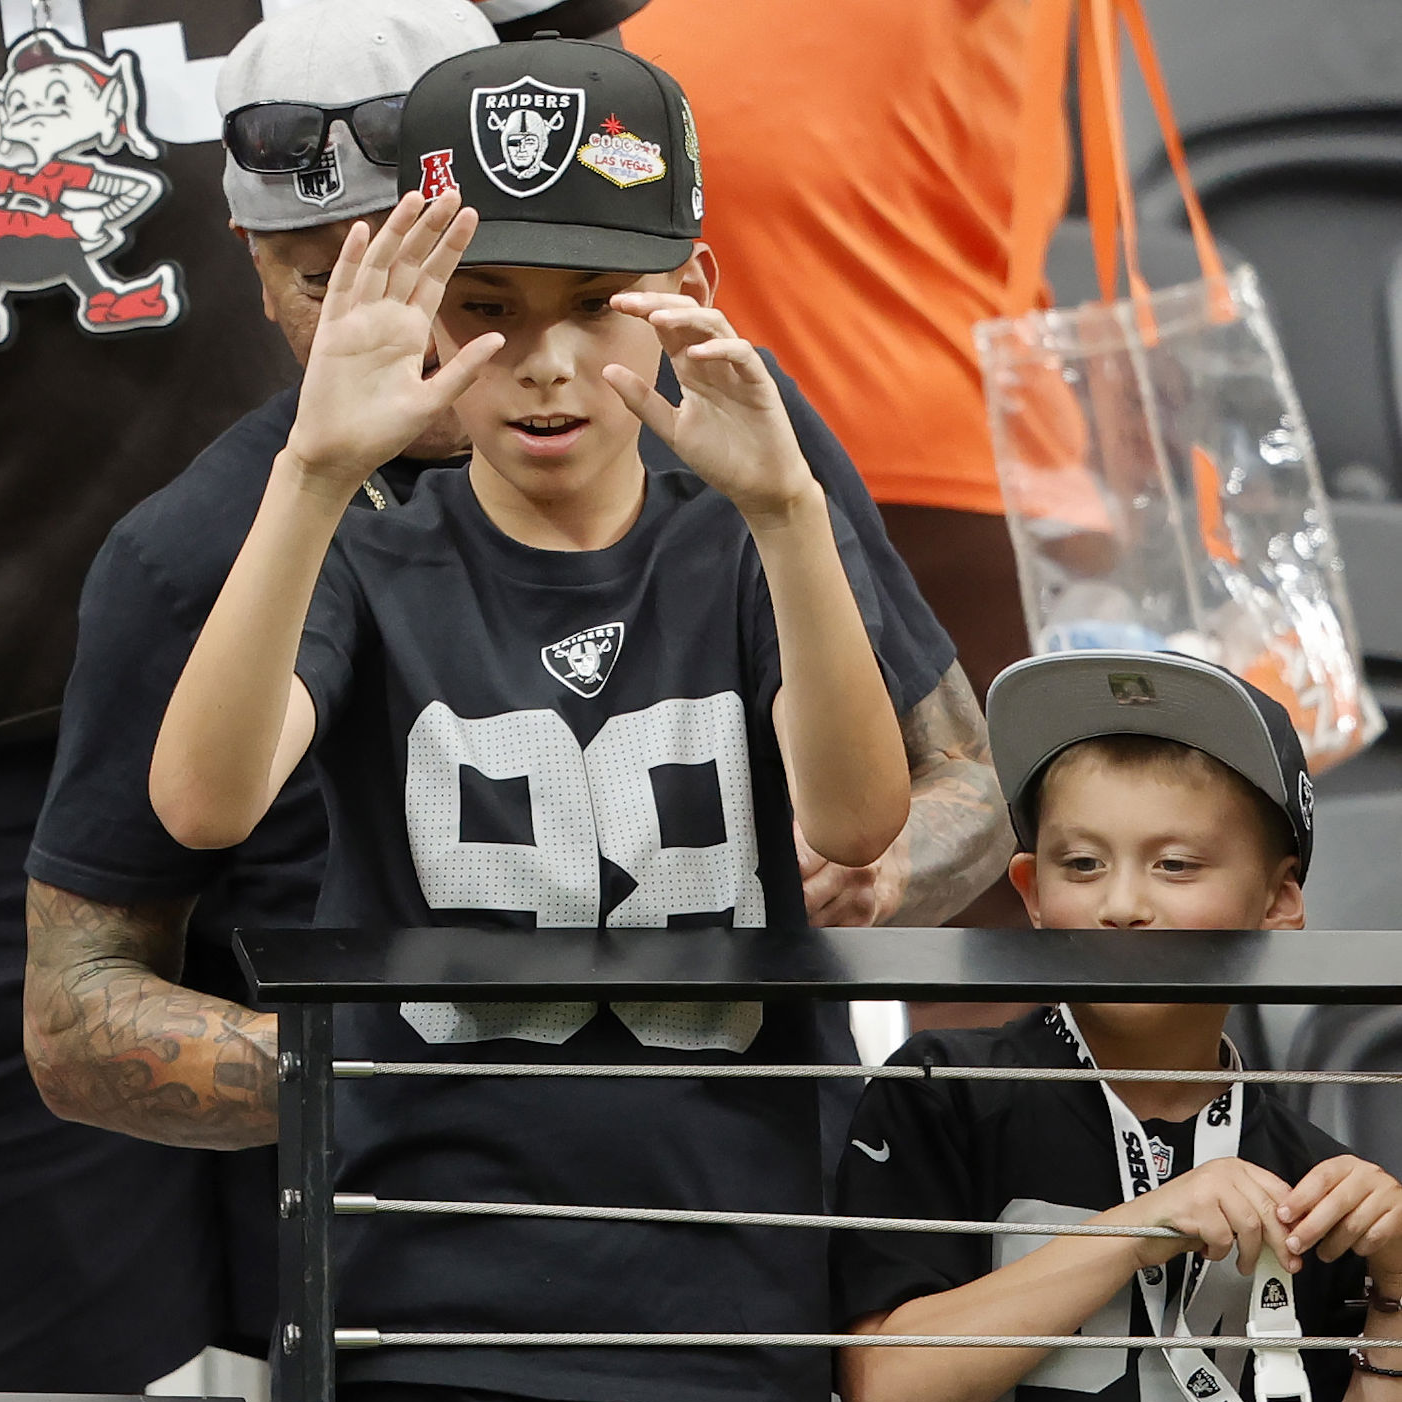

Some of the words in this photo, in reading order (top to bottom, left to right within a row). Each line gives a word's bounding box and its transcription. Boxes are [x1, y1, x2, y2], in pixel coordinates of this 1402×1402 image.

[485, 93, 571, 109] RAIDERS
[595, 154, 616, 167] LAS
[619, 158, 653, 174] VEGAS
[300, 170, 338, 197] NFL
